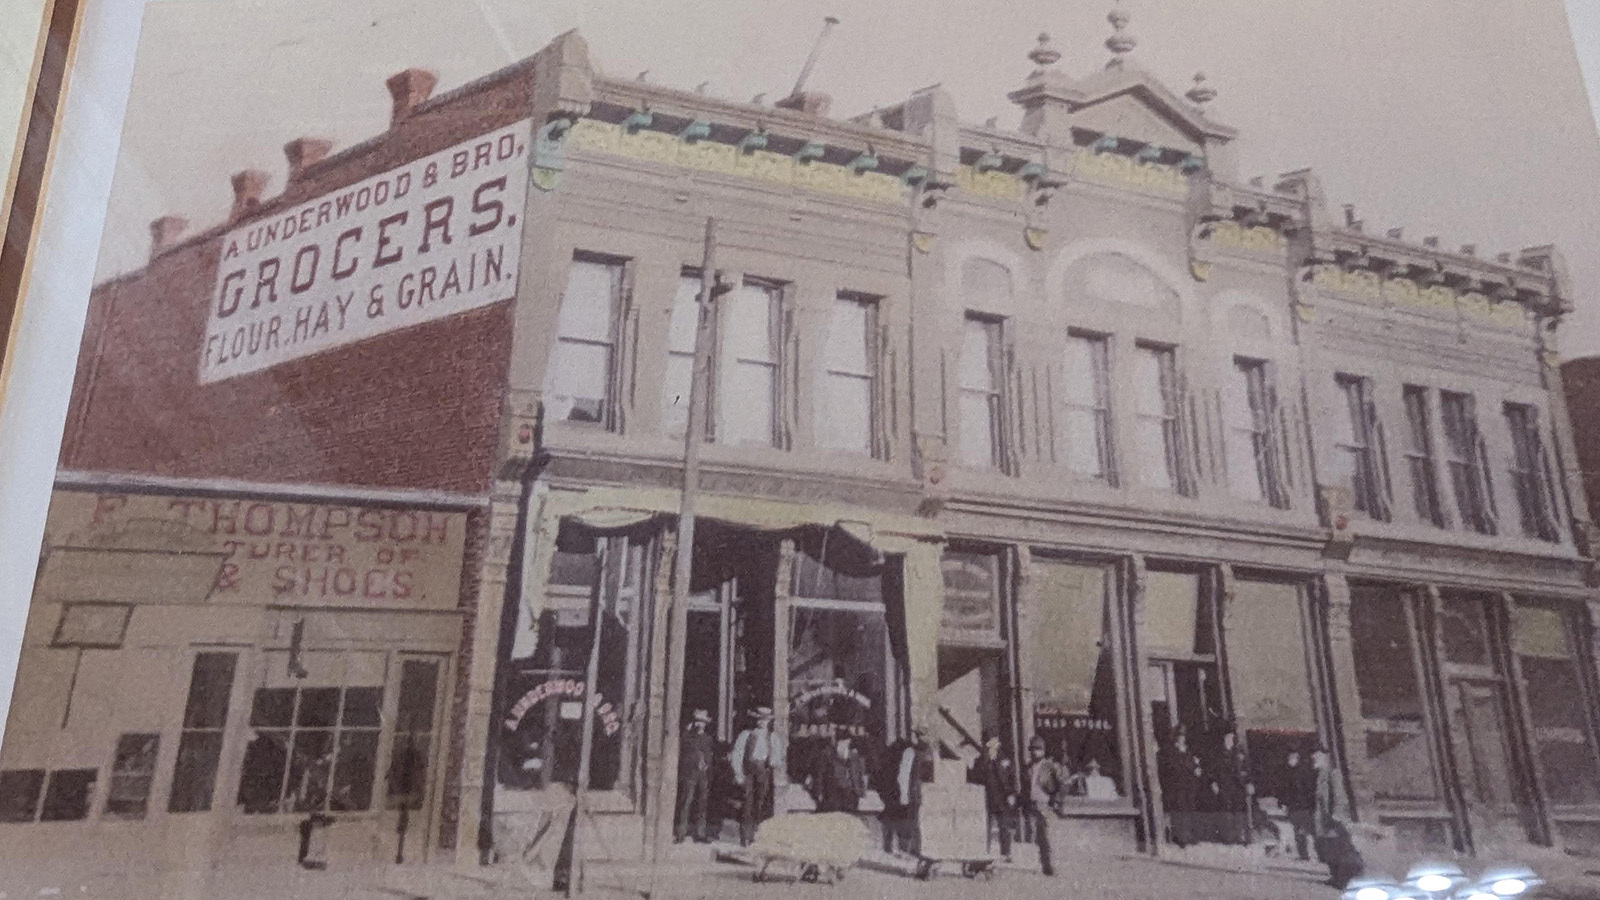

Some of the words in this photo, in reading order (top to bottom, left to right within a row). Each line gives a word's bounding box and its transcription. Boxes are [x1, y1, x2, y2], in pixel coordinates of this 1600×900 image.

[216, 174, 517, 319] GROCERS.
[246, 172, 412, 252] UNDERWOOD
[422, 162, 439, 188] &
[366, 284, 384, 320] &
[397, 244, 513, 310] GRAIN.
